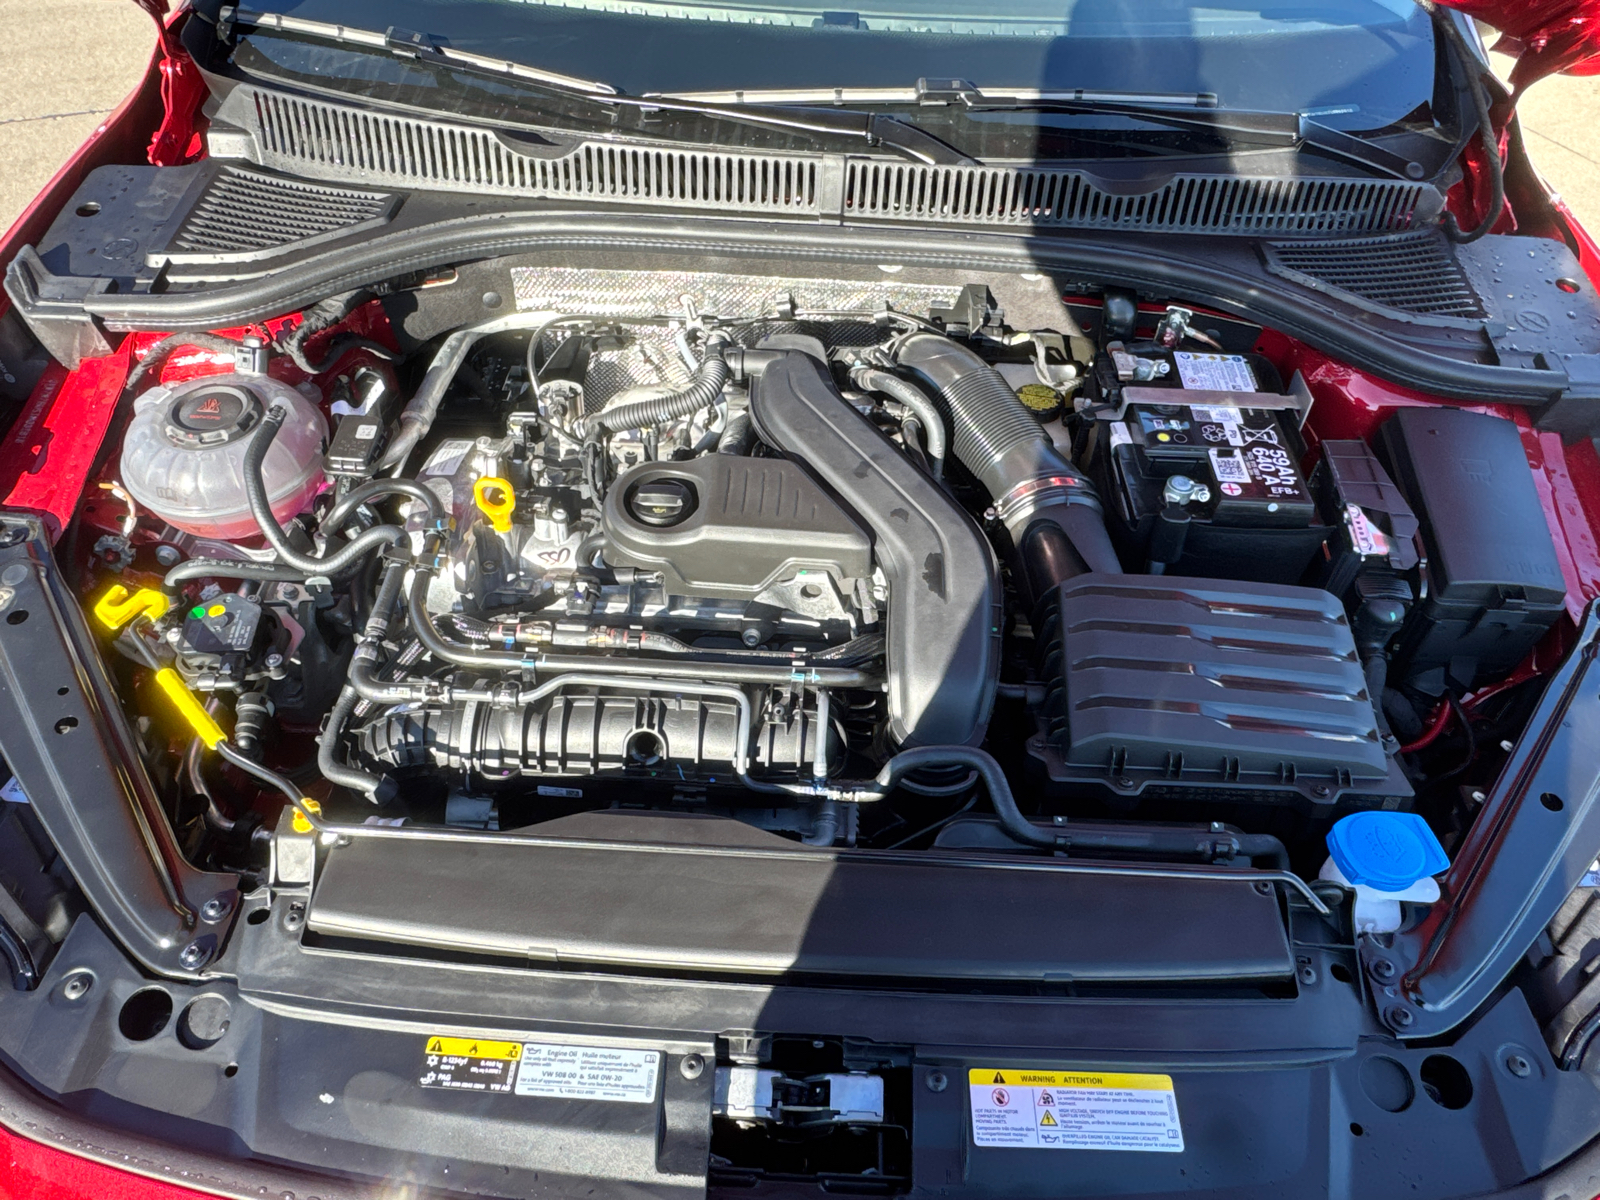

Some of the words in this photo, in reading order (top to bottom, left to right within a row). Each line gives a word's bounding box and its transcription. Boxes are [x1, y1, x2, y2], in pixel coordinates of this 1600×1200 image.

[1252, 446, 1276, 472] 640
[1270, 449, 1298, 485] 59Ah
[1262, 474, 1281, 486] A
[1270, 486, 1300, 496] EFB+
[1020, 1075, 1056, 1084] WARNING
[1064, 1076, 1103, 1085] ATTENTION
